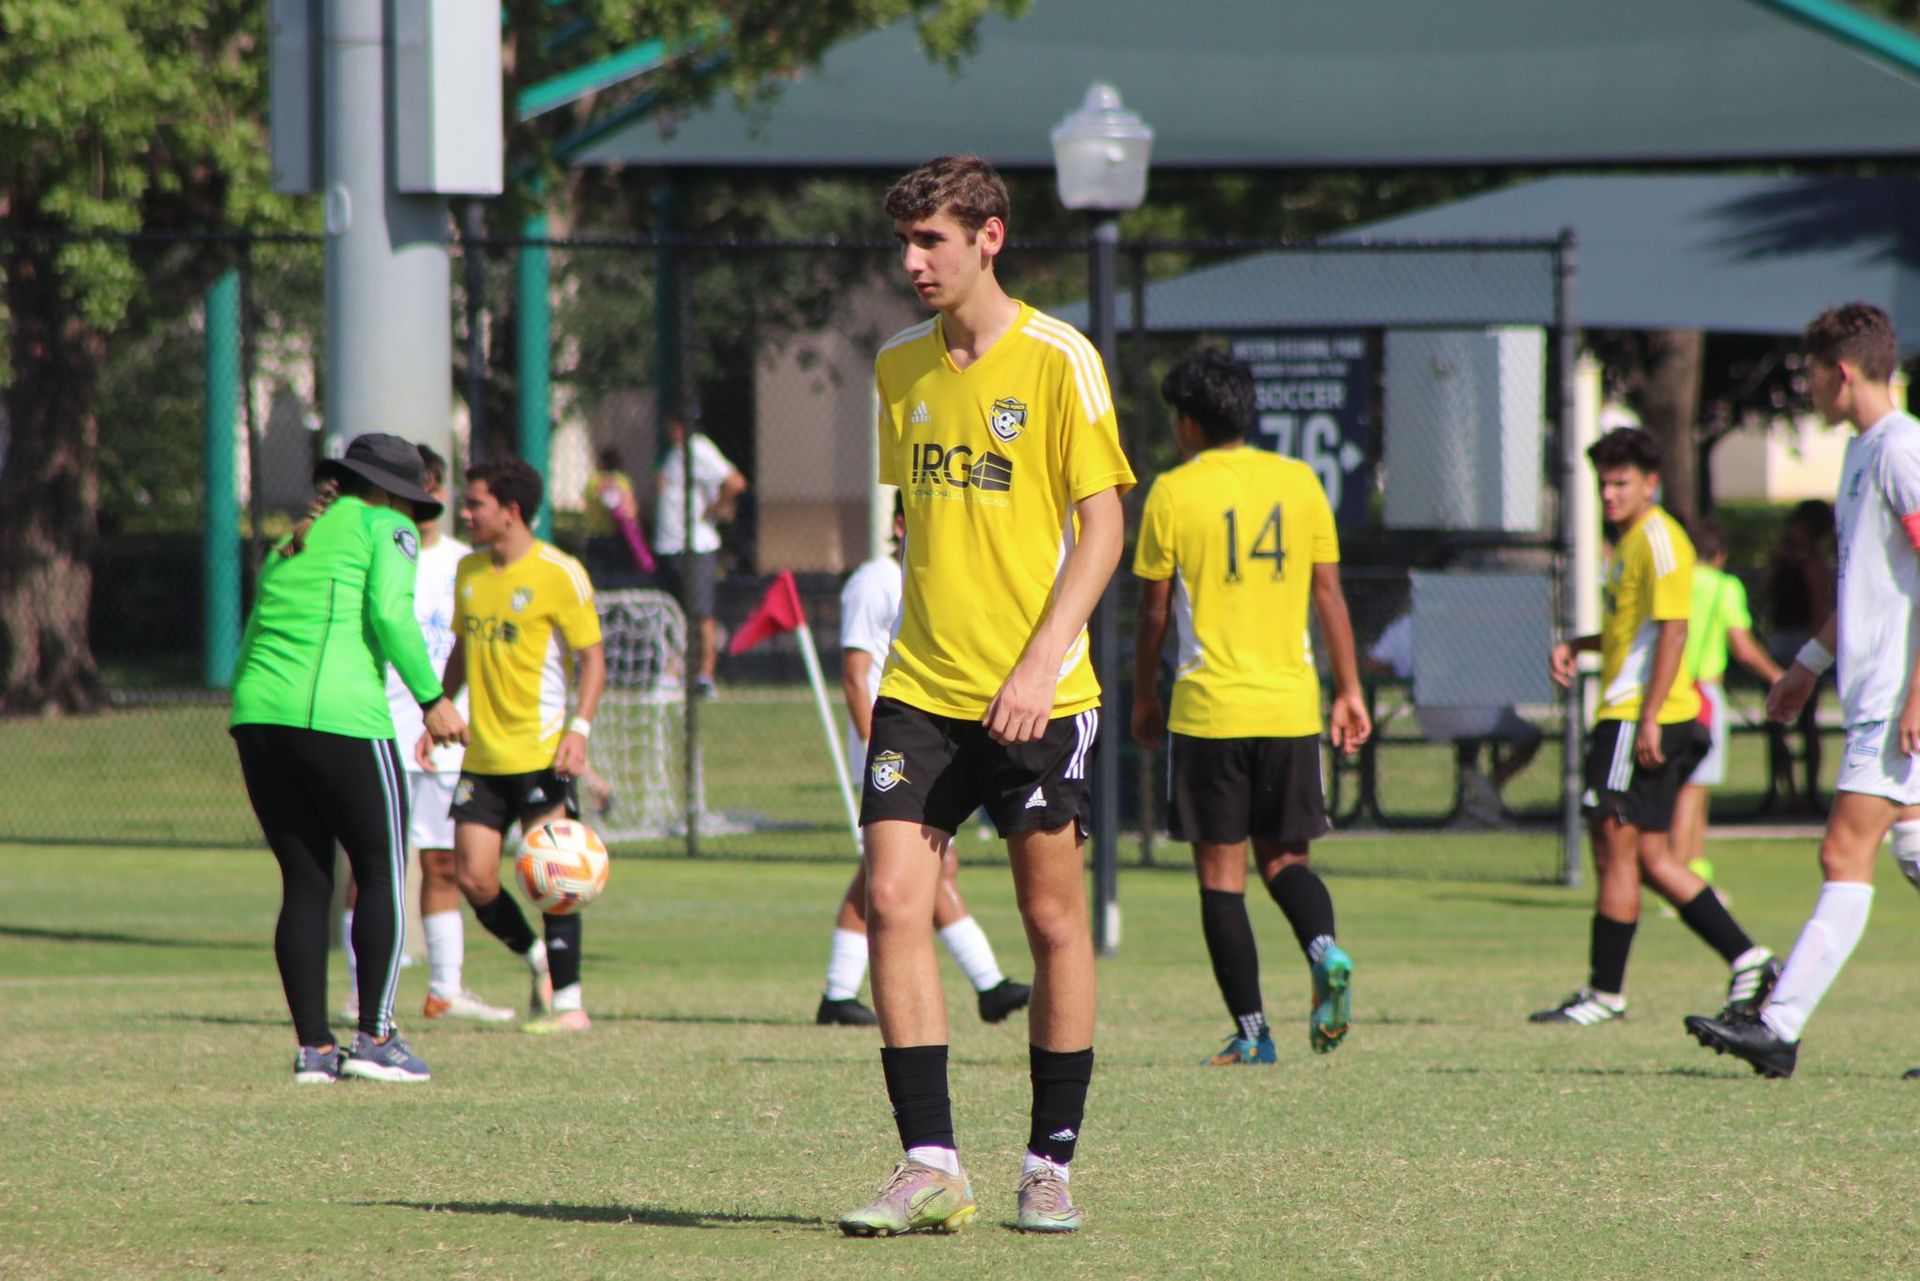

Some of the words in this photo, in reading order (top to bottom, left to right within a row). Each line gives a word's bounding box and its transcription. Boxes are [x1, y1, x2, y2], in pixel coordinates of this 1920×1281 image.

[1255, 383, 1345, 411] SOCCER
[912, 443, 973, 488] IRG
[1222, 502, 1286, 583] 14
